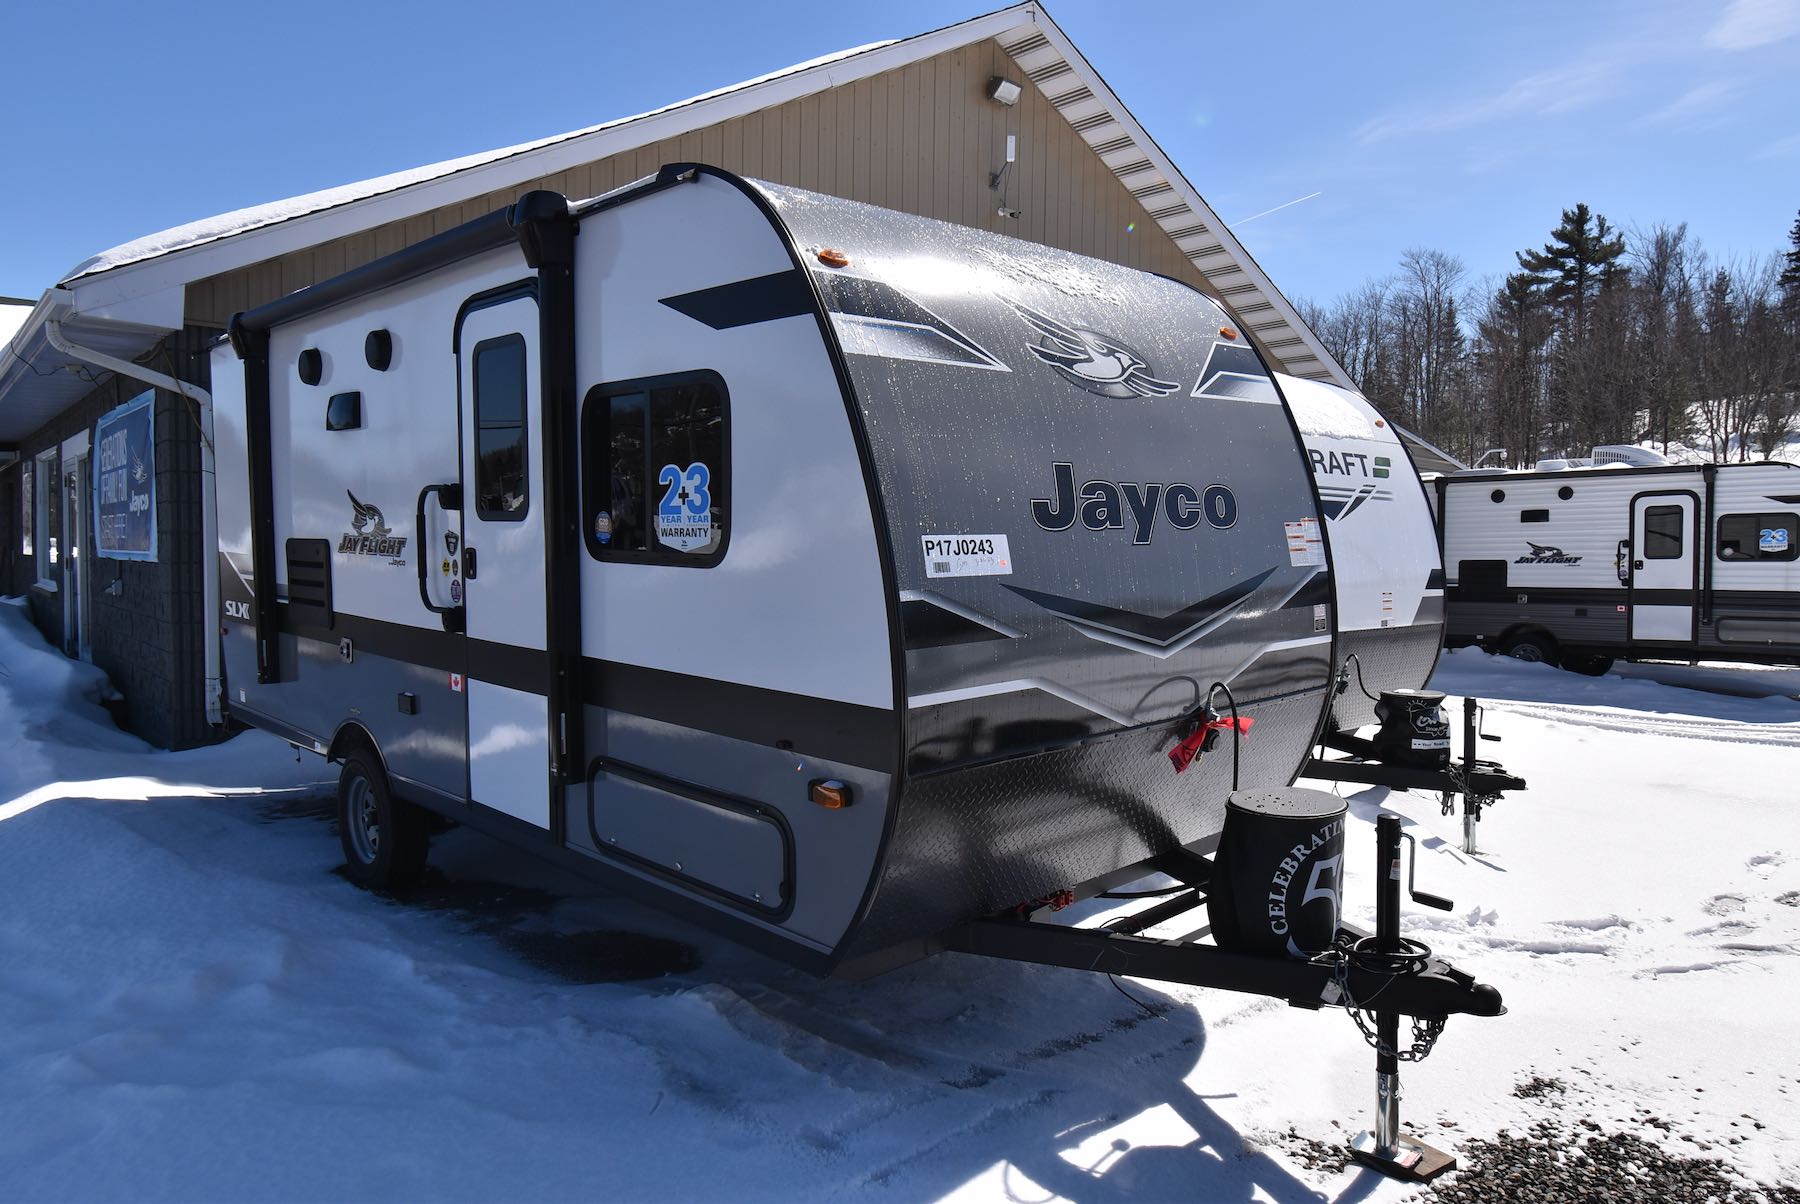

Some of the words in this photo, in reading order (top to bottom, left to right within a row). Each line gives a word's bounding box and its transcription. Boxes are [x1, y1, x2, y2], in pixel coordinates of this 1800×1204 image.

[130, 490, 149, 516] Jayco
[1030, 461, 1239, 545] Jayco
[661, 515, 682, 523] YEAR
[687, 515, 709, 523] YEAR
[661, 528, 709, 538] WARRANTY
[338, 533, 360, 554] JAY
[358, 536, 407, 557] FLIGHT
[925, 539, 994, 556] P17J0243
[1536, 556, 1583, 564] FLIGHT
[225, 600, 250, 620] SLX
